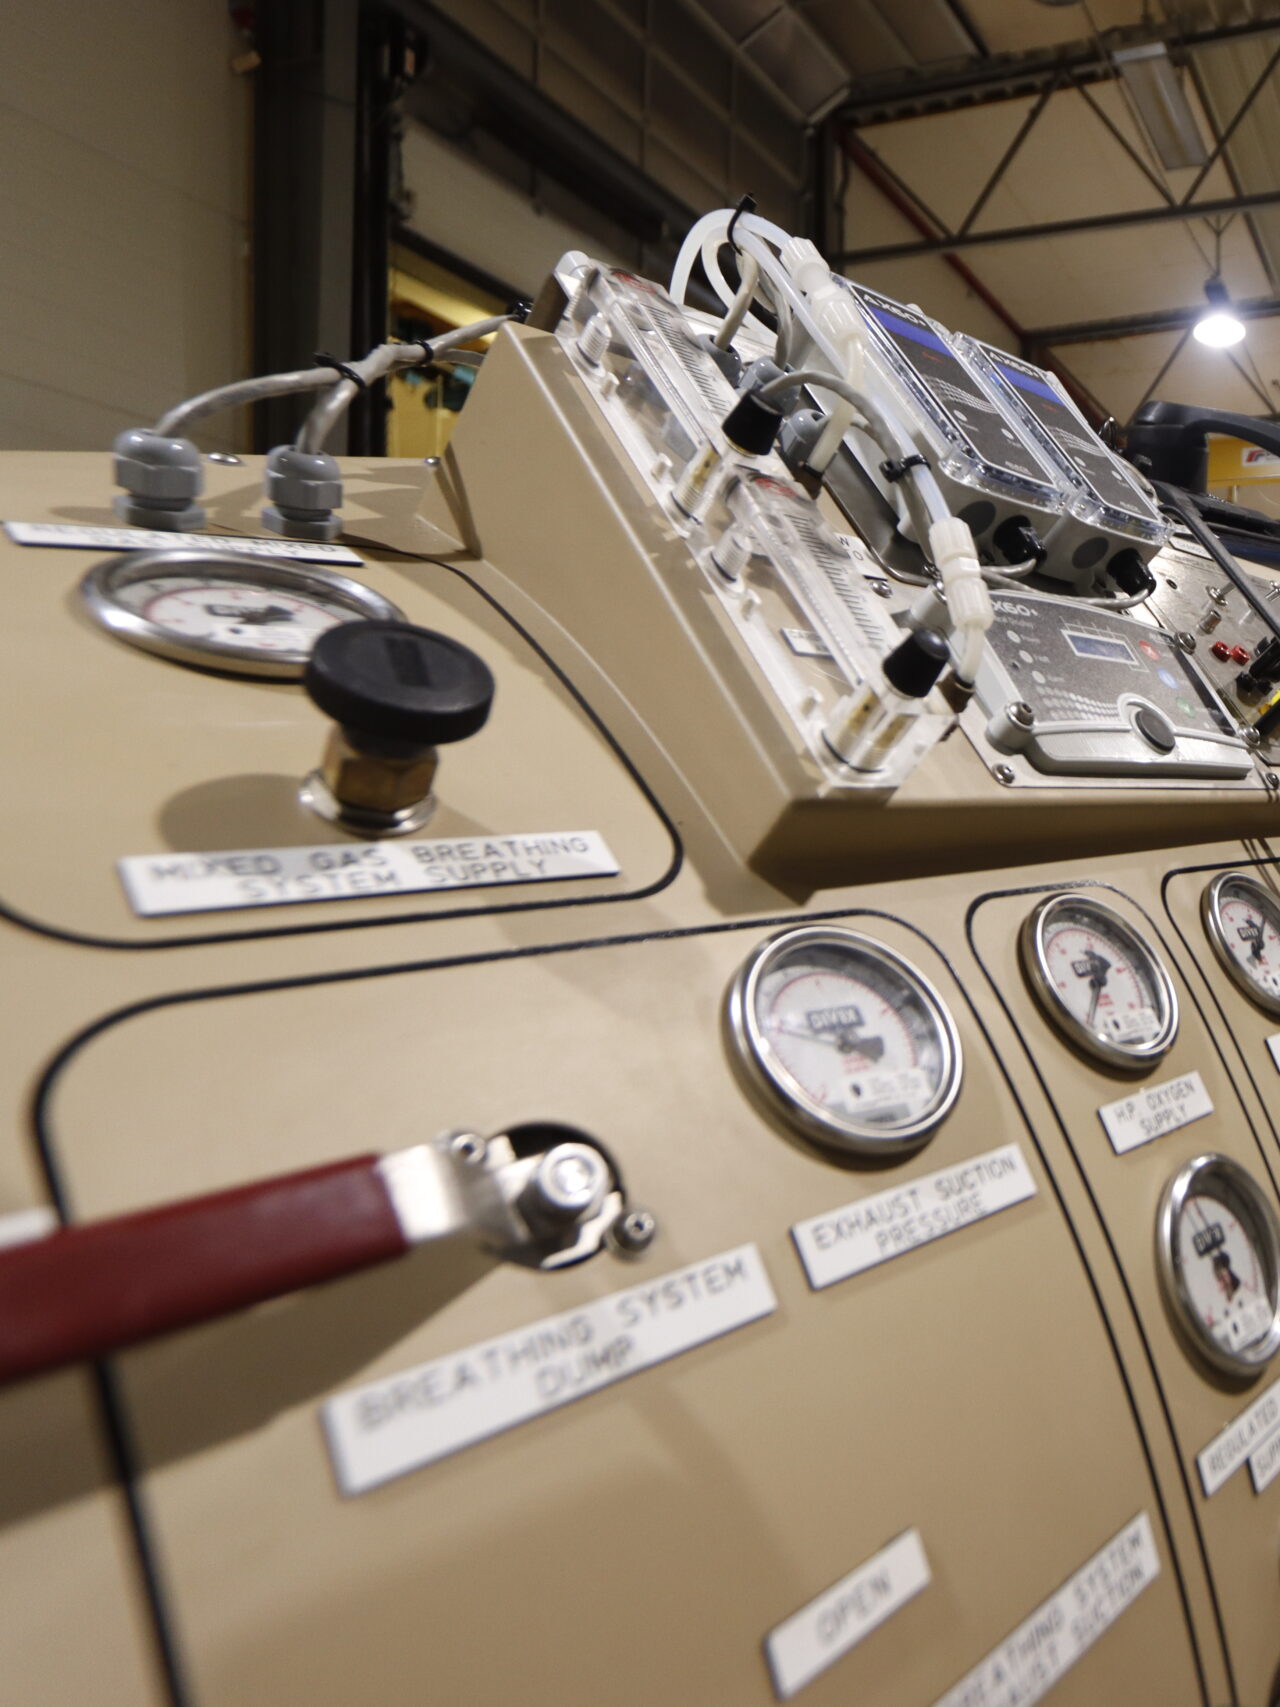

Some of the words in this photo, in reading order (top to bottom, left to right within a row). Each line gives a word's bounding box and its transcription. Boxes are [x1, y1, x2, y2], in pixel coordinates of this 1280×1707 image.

[150, 856, 280, 884] MIXED
[309, 846, 390, 871] GAS
[411, 836, 589, 864] BREATHING
[239, 871, 399, 899] SYSTEM
[425, 859, 548, 883] SUPPLY
[1140, 1104, 1186, 1136] SUPPLY
[1146, 1080, 1196, 1110] OXYGEN
[812, 1189, 920, 1250] EXHAUST
[934, 1156, 1017, 1200] SUCTION
[876, 1191, 987, 1257] PRESSURE
[356, 1315, 595, 1433] BREATHING
[616, 1257, 747, 1327] SYSTEM
[534, 1336, 637, 1398] DUMP
